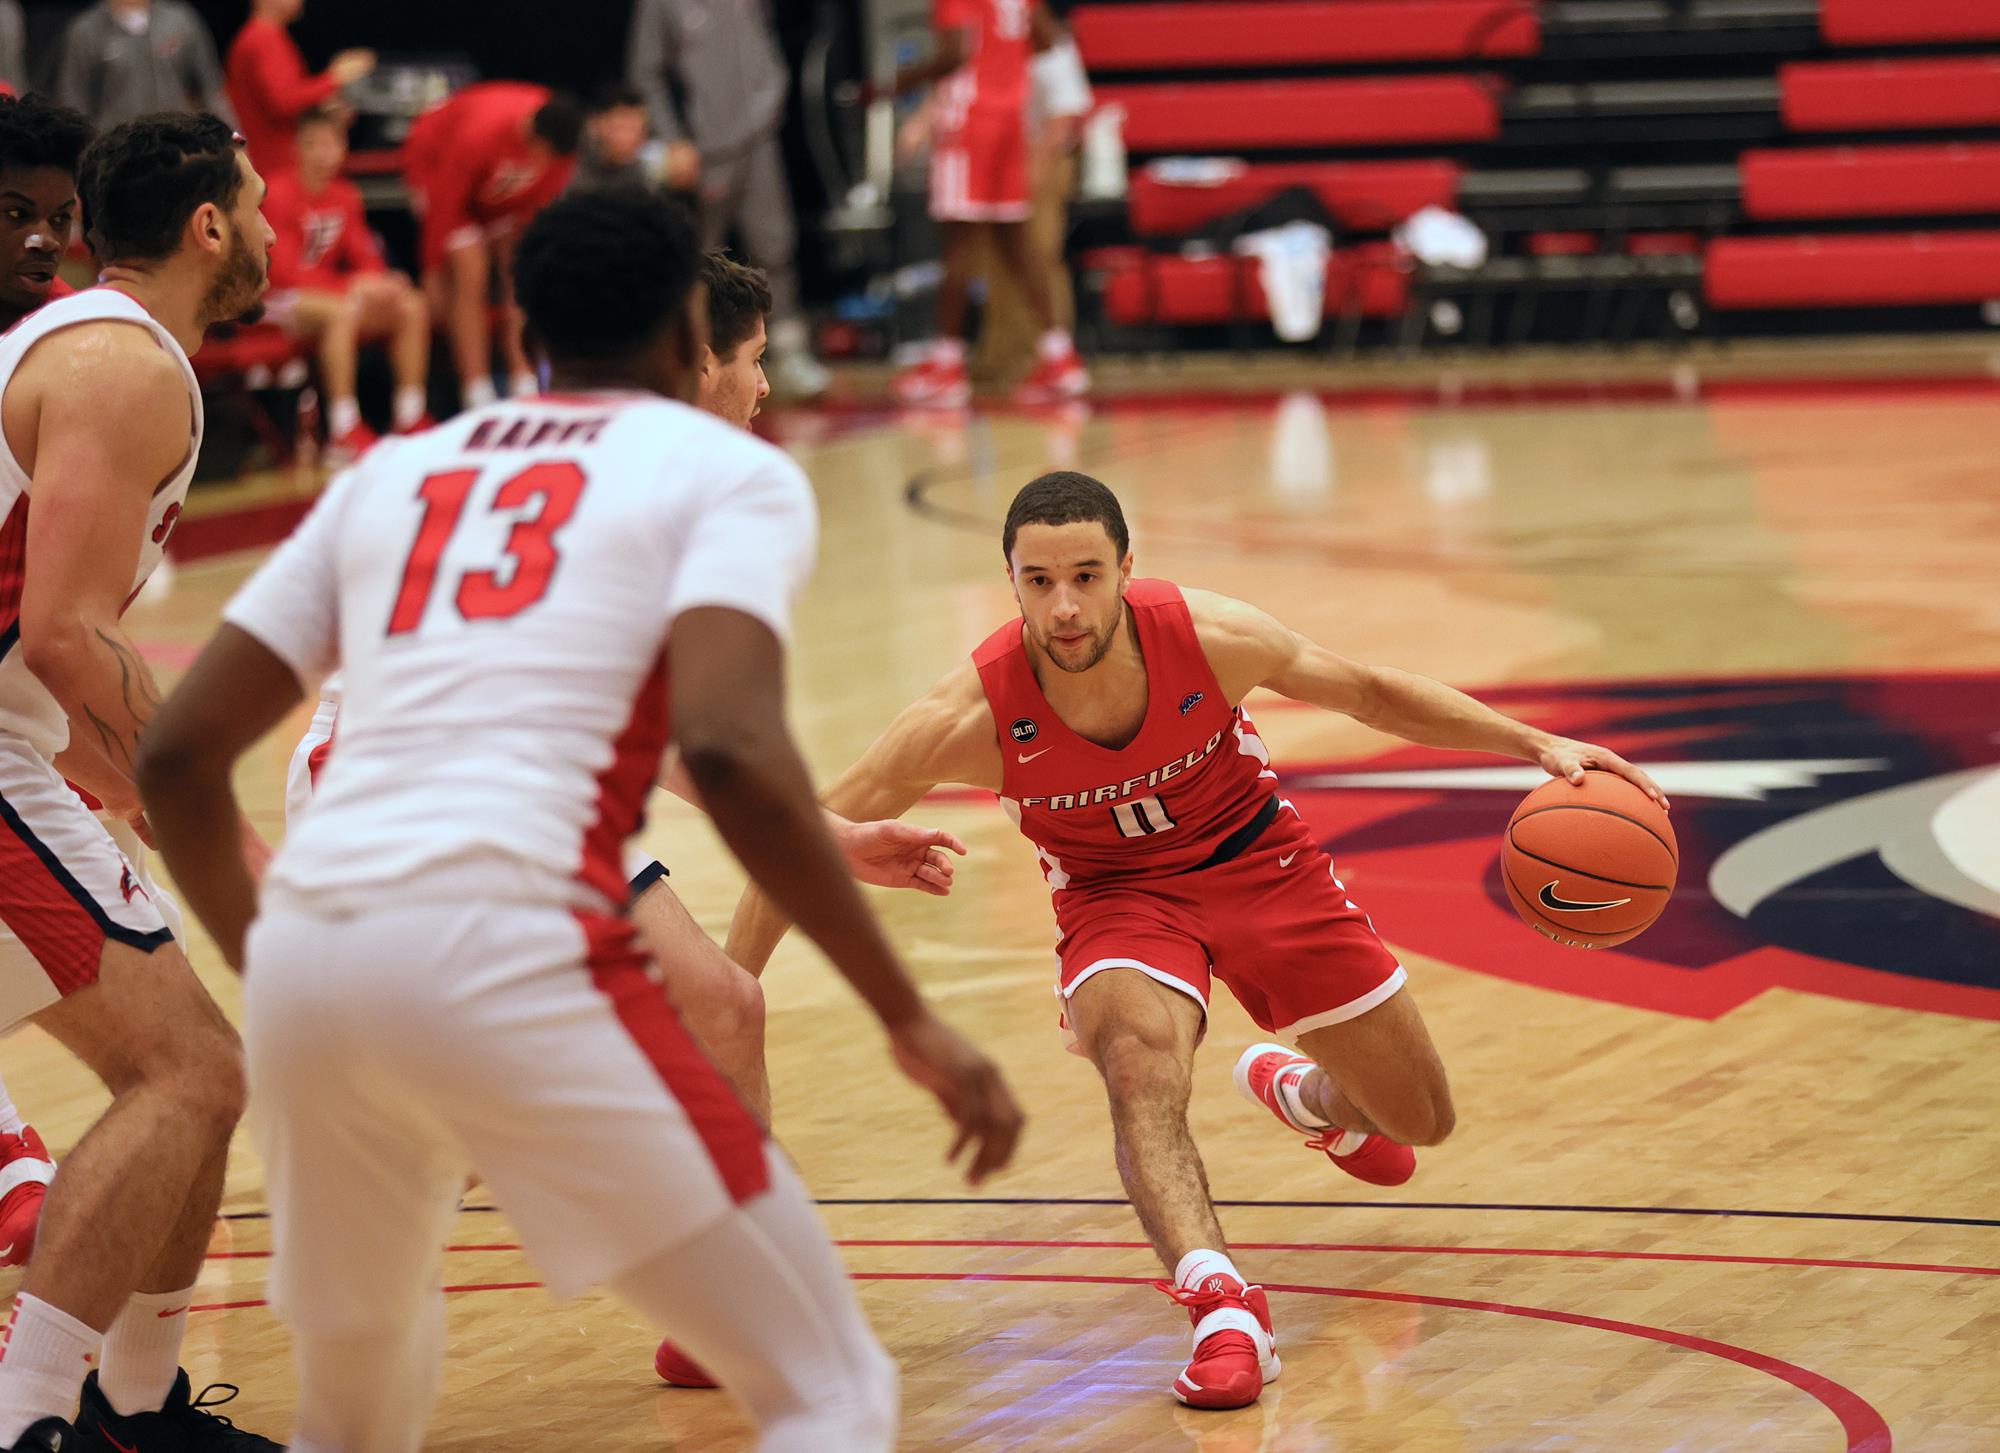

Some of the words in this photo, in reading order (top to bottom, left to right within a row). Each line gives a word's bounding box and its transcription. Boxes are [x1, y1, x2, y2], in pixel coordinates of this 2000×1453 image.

[384, 459, 588, 637] 13
[1012, 724, 1035, 738] BLM
[1022, 730, 1222, 811] FAIRFIELD
